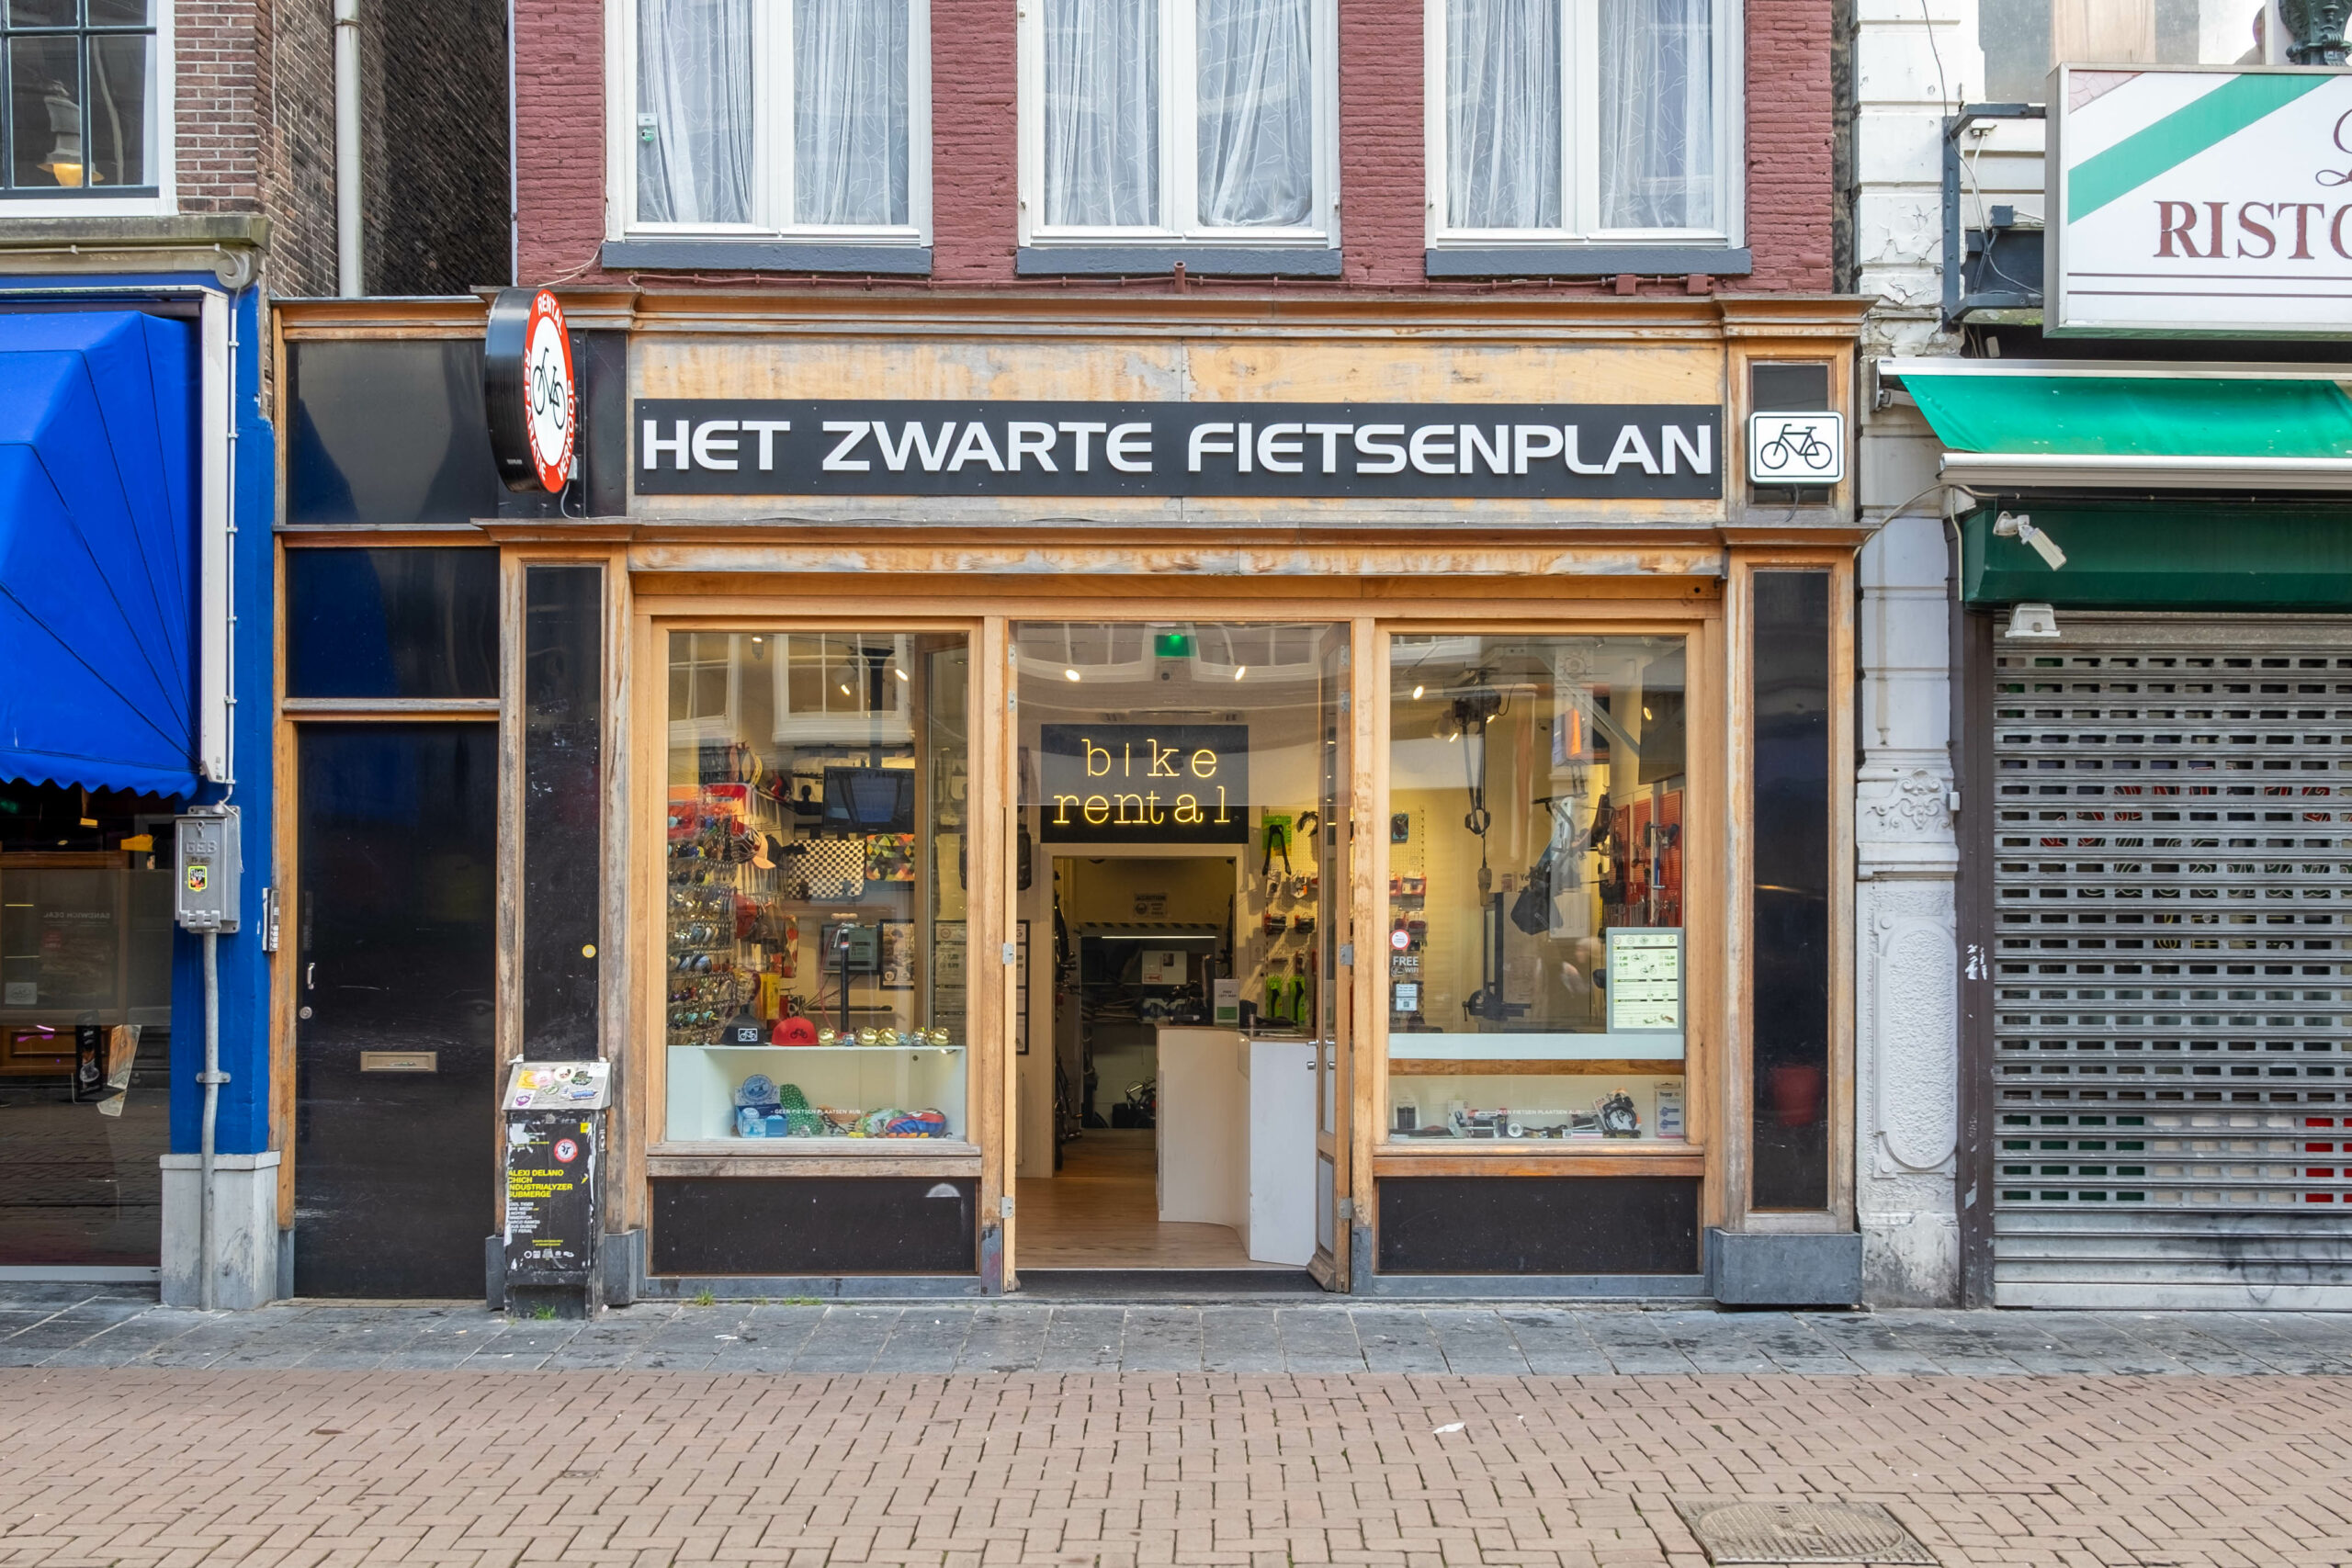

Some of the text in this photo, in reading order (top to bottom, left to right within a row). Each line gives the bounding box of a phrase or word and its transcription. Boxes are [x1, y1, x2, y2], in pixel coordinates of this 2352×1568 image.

[537, 293, 562, 336] RENTAL
[524, 347, 547, 481] REPARATIE
[557, 379, 574, 481] VERKOOP
[643, 420, 1712, 475] HET ZWARTE FIETSENPLAN
[1081, 739, 1217, 778] bike
[1053, 785, 1230, 825] rental
[1393, 956, 1419, 965] FREE
